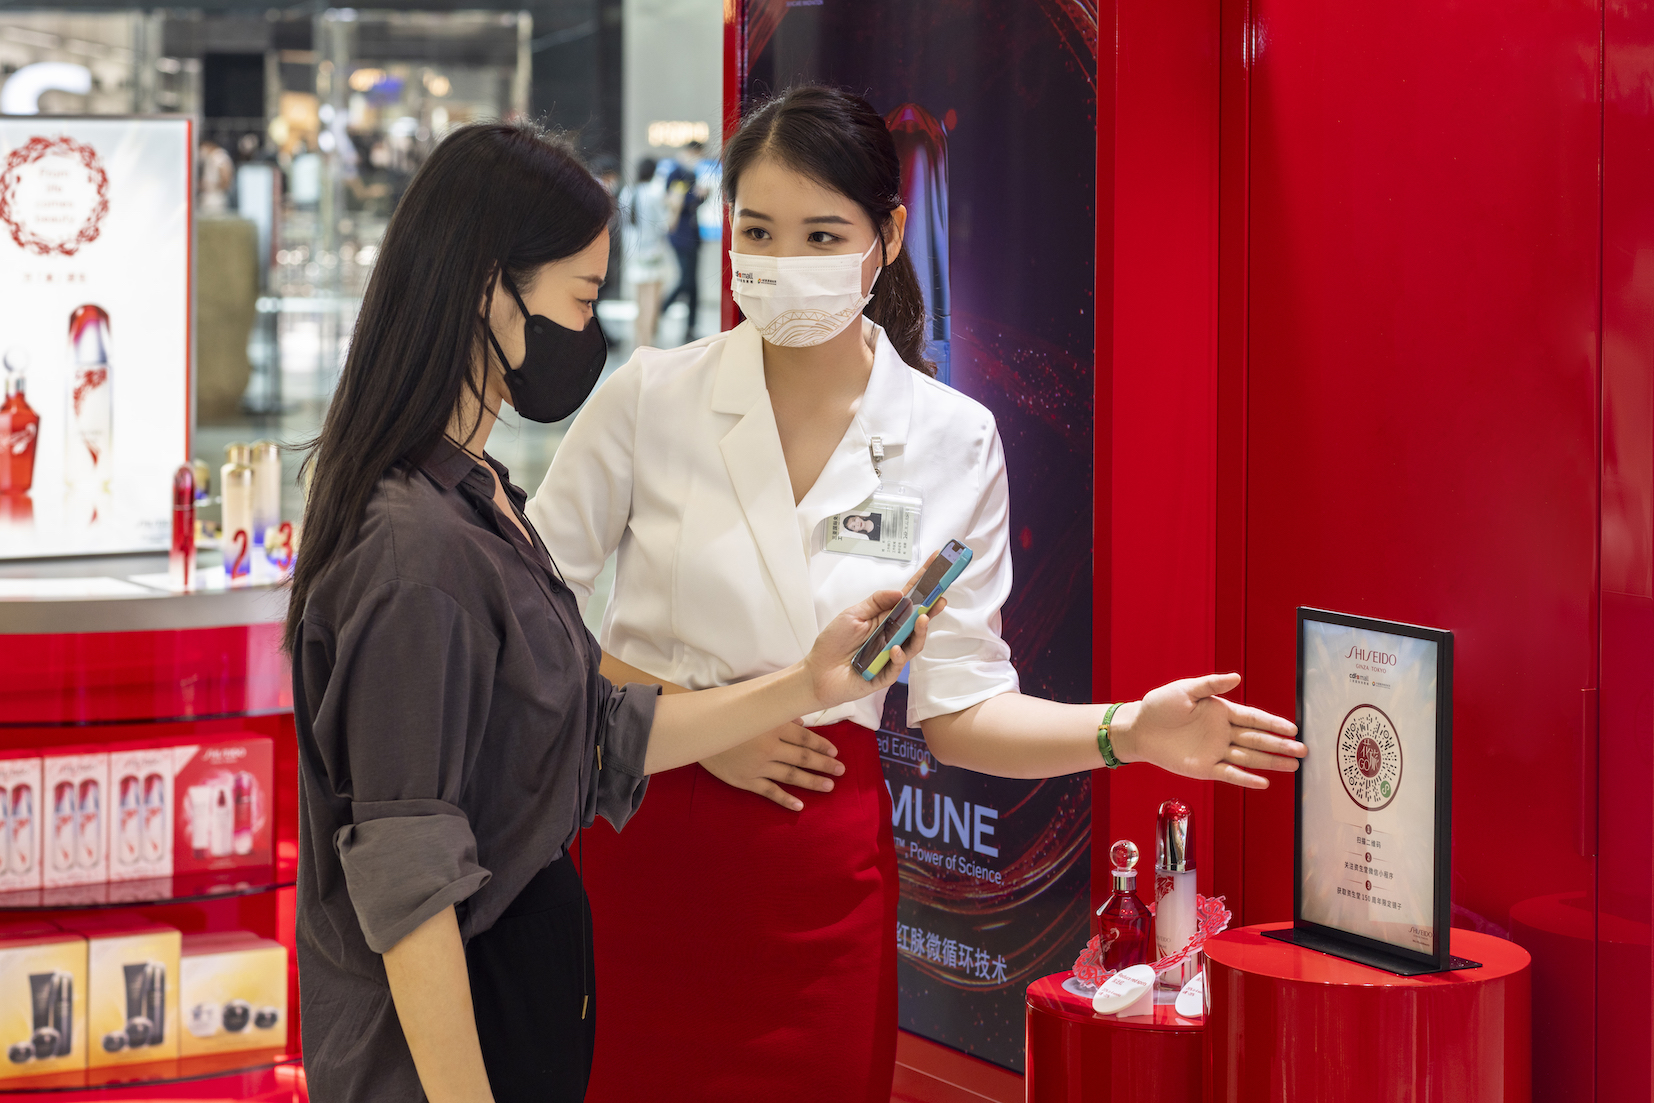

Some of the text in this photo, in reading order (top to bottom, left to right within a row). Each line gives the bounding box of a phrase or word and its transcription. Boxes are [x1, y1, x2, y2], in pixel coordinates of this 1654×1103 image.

[231, 529, 247, 579] 2
[277, 522, 293, 571] 3
[1344, 645, 1397, 666] SHISEIDO
[1355, 663, 1387, 674] GINZA TOKYO
[892, 737, 931, 764] Edition
[885, 779, 999, 858] MUNE
[910, 841, 943, 867] Power
[945, 854, 957, 871] of
[958, 856, 1005, 886] Science.
[897, 921, 1007, 984] 红脉微循环技术
